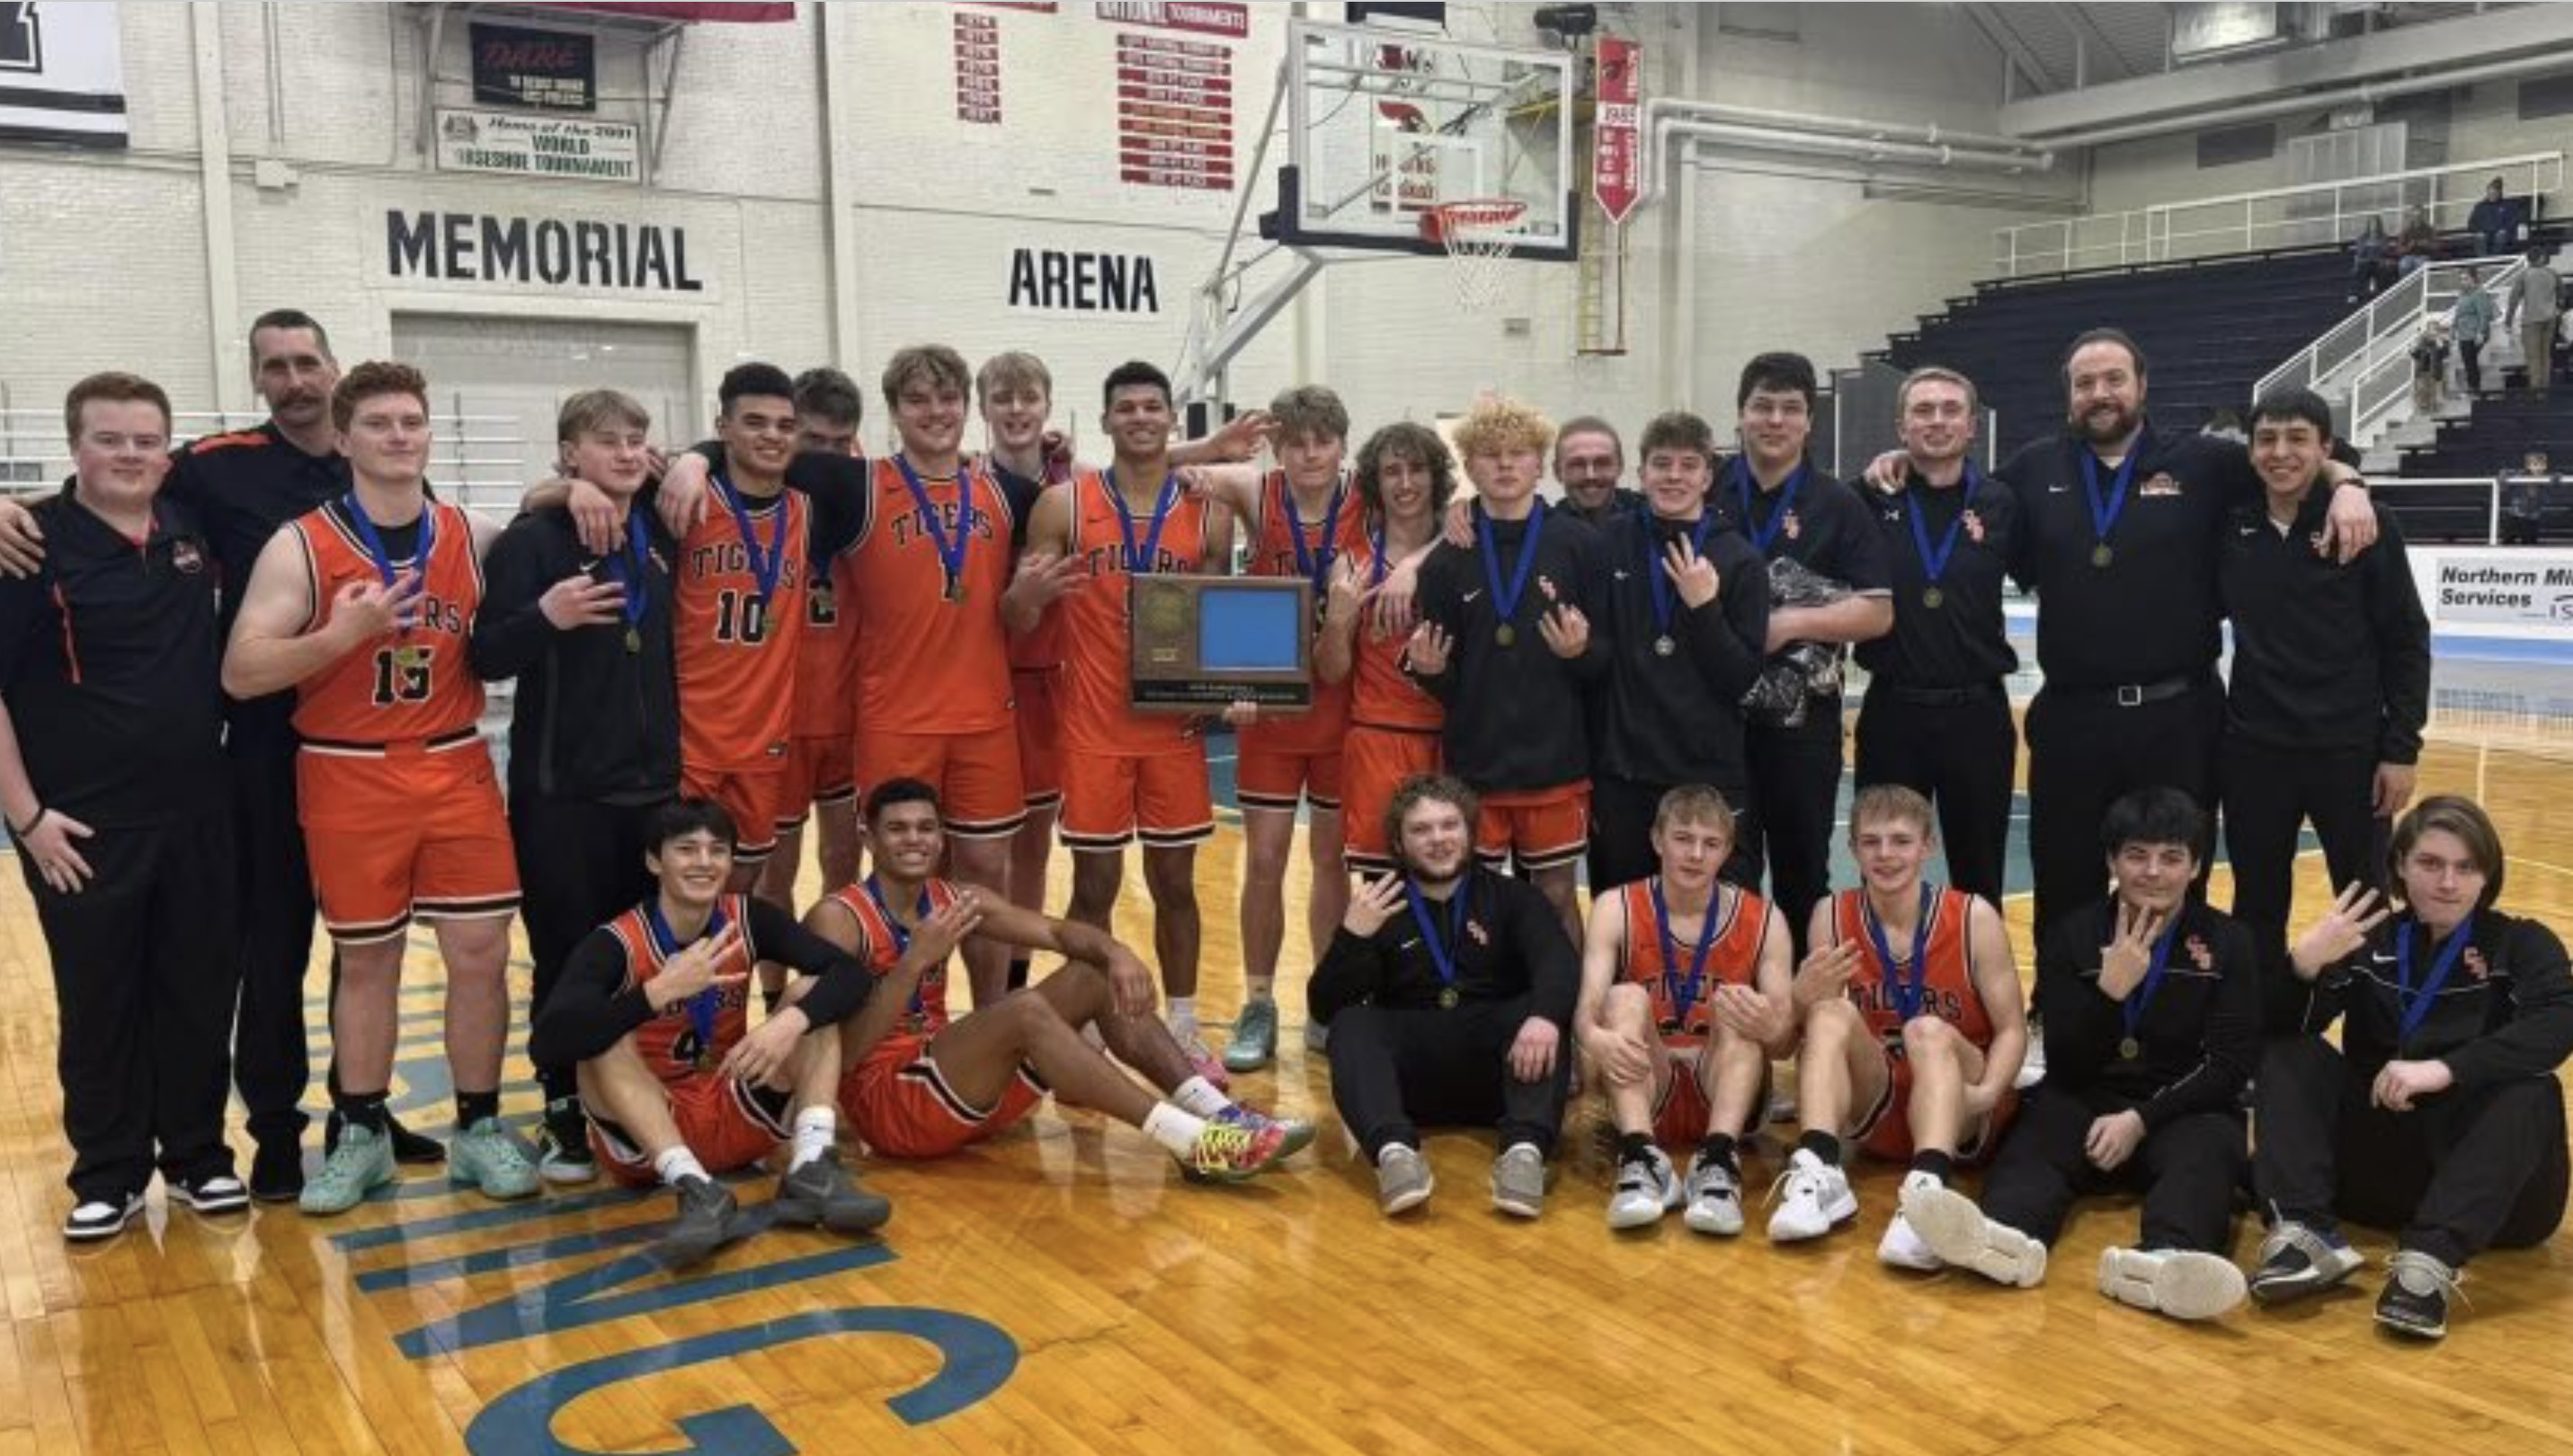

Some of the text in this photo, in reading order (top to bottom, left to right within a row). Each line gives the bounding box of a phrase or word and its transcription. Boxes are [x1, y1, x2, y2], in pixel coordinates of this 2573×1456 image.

[532, 136, 590, 155] WORLD
[541, 122, 561, 135] of
[565, 123, 592, 136] the
[535, 155, 634, 178] TOURNAMENT
[387, 209, 703, 291] MEMORIAL
[1008, 248, 1160, 313] ARENA
[692, 541, 797, 590] TIGS
[2441, 565, 2537, 585] Northern
[2441, 588, 2533, 608] Services
[714, 587, 769, 646] 10
[371, 645, 435, 707] 15
